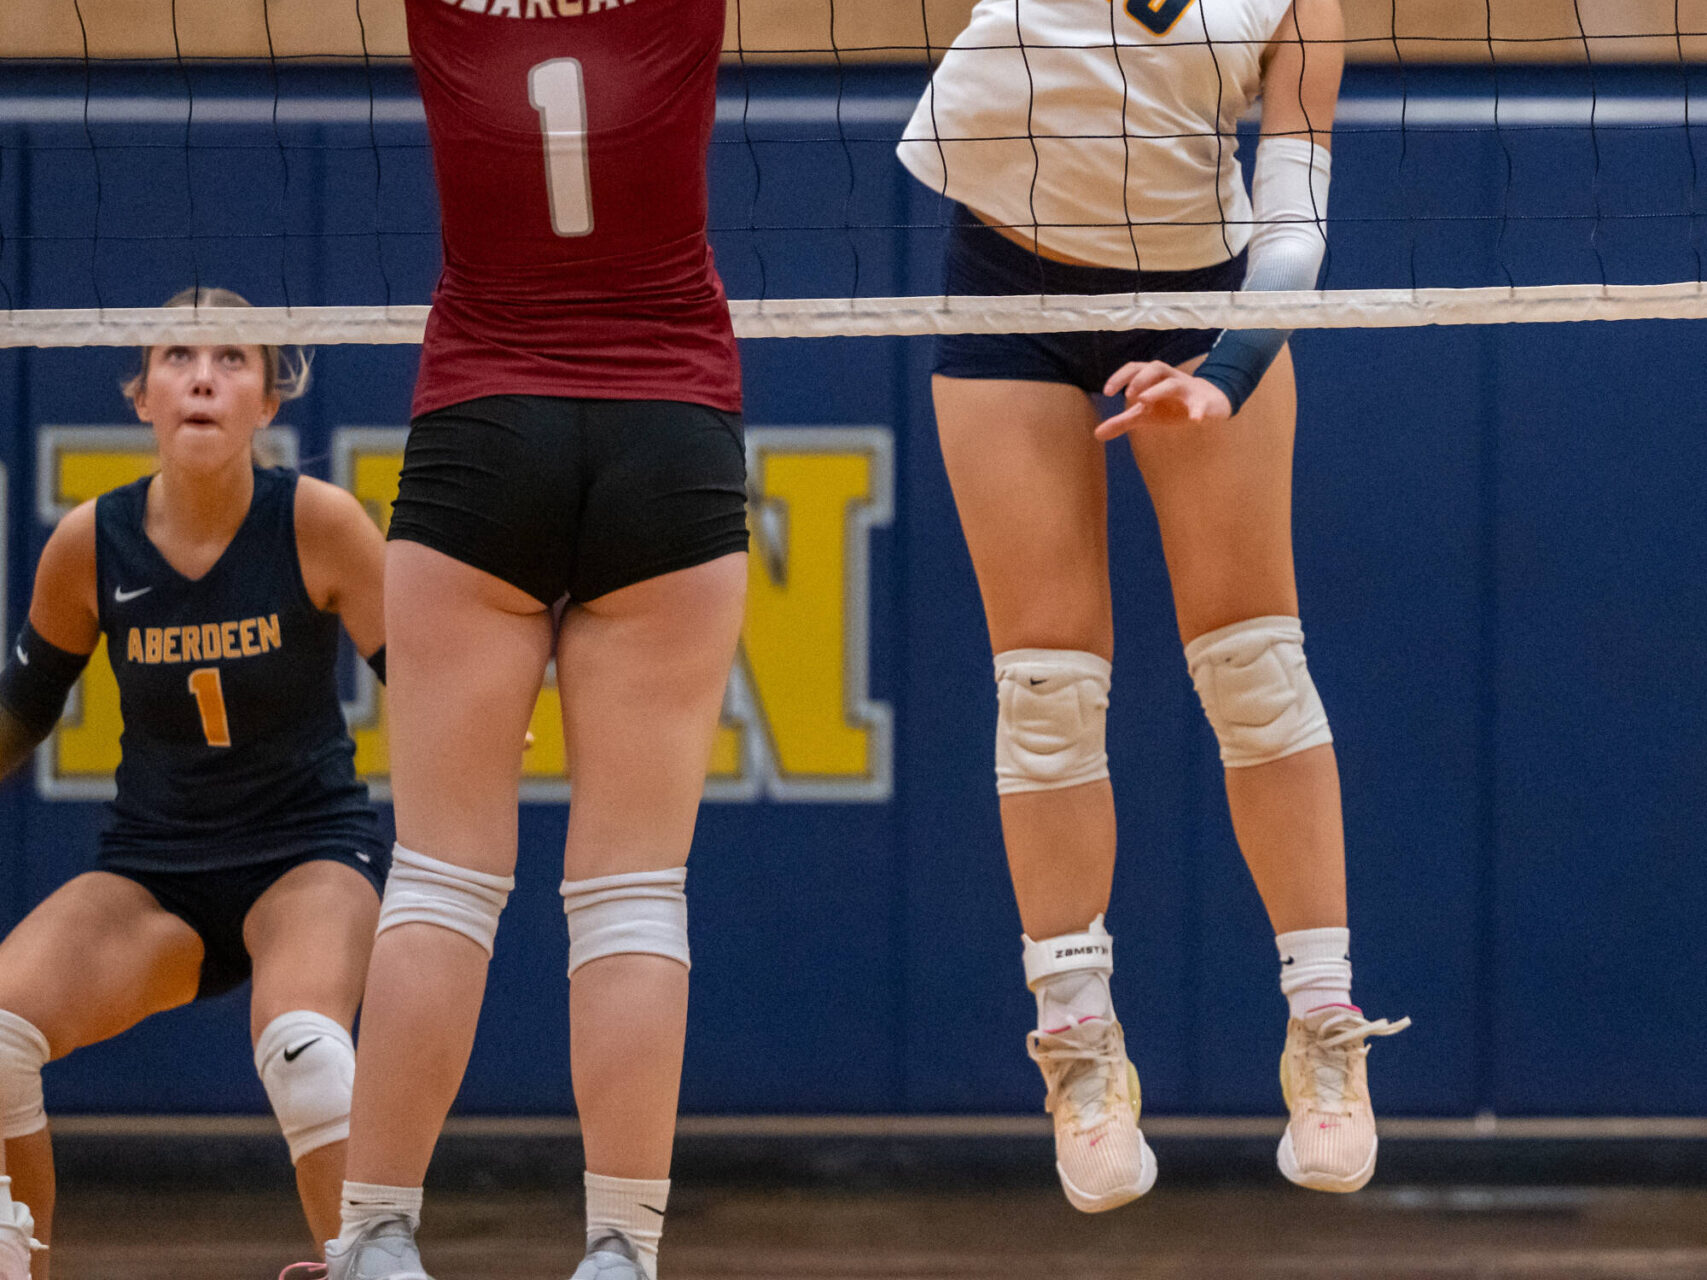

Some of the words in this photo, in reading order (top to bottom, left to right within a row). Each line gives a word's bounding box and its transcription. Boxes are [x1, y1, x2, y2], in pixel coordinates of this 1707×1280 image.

[527, 56, 595, 238] 1
[127, 613, 282, 664] ABERDEEN
[187, 667, 231, 747] 1
